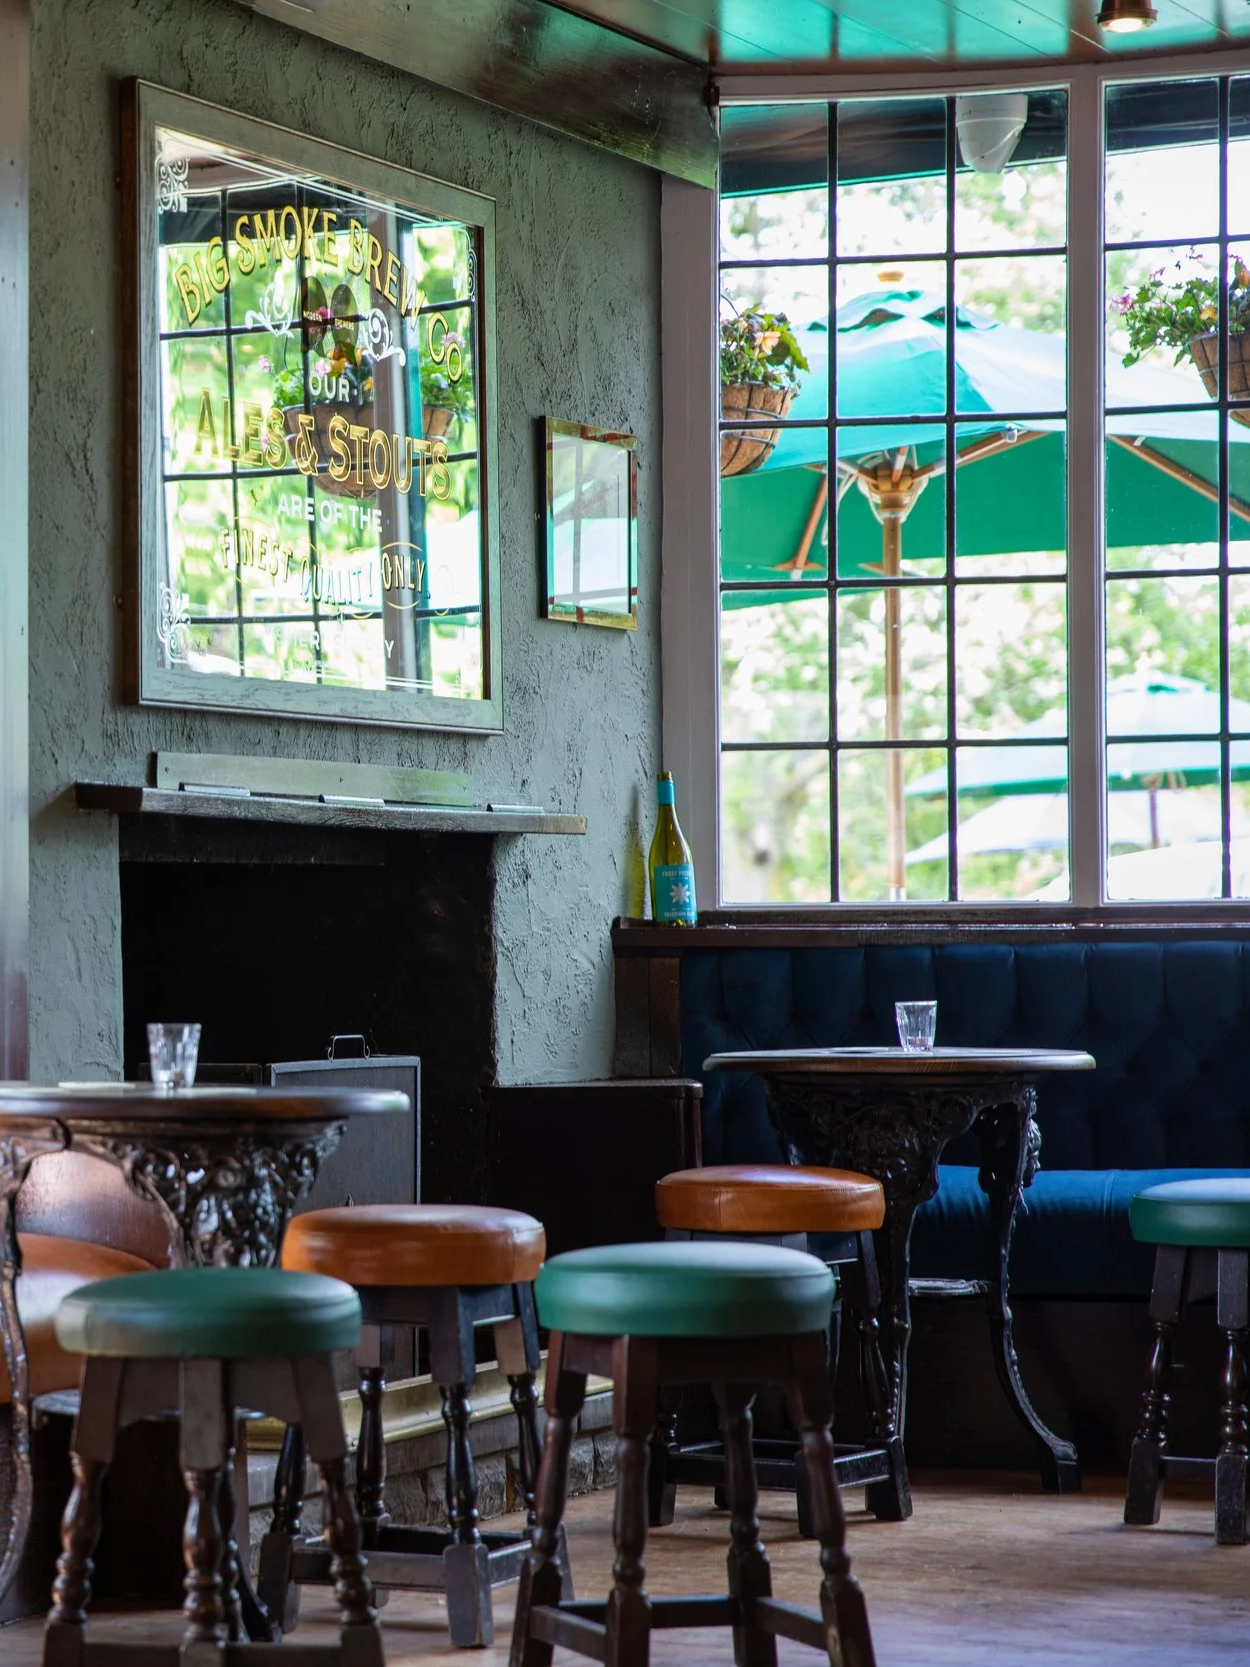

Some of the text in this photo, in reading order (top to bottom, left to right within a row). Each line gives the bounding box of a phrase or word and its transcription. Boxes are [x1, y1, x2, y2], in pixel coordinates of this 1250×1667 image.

[175, 205, 462, 383] BIG SMOKE BREW CO
[309, 374, 350, 403] OUR
[193, 387, 451, 500] ALES & STOUTS
[277, 493, 383, 533] ARE OF THE
[220, 528, 294, 583] FINEST
[381, 552, 427, 593] ONLY
